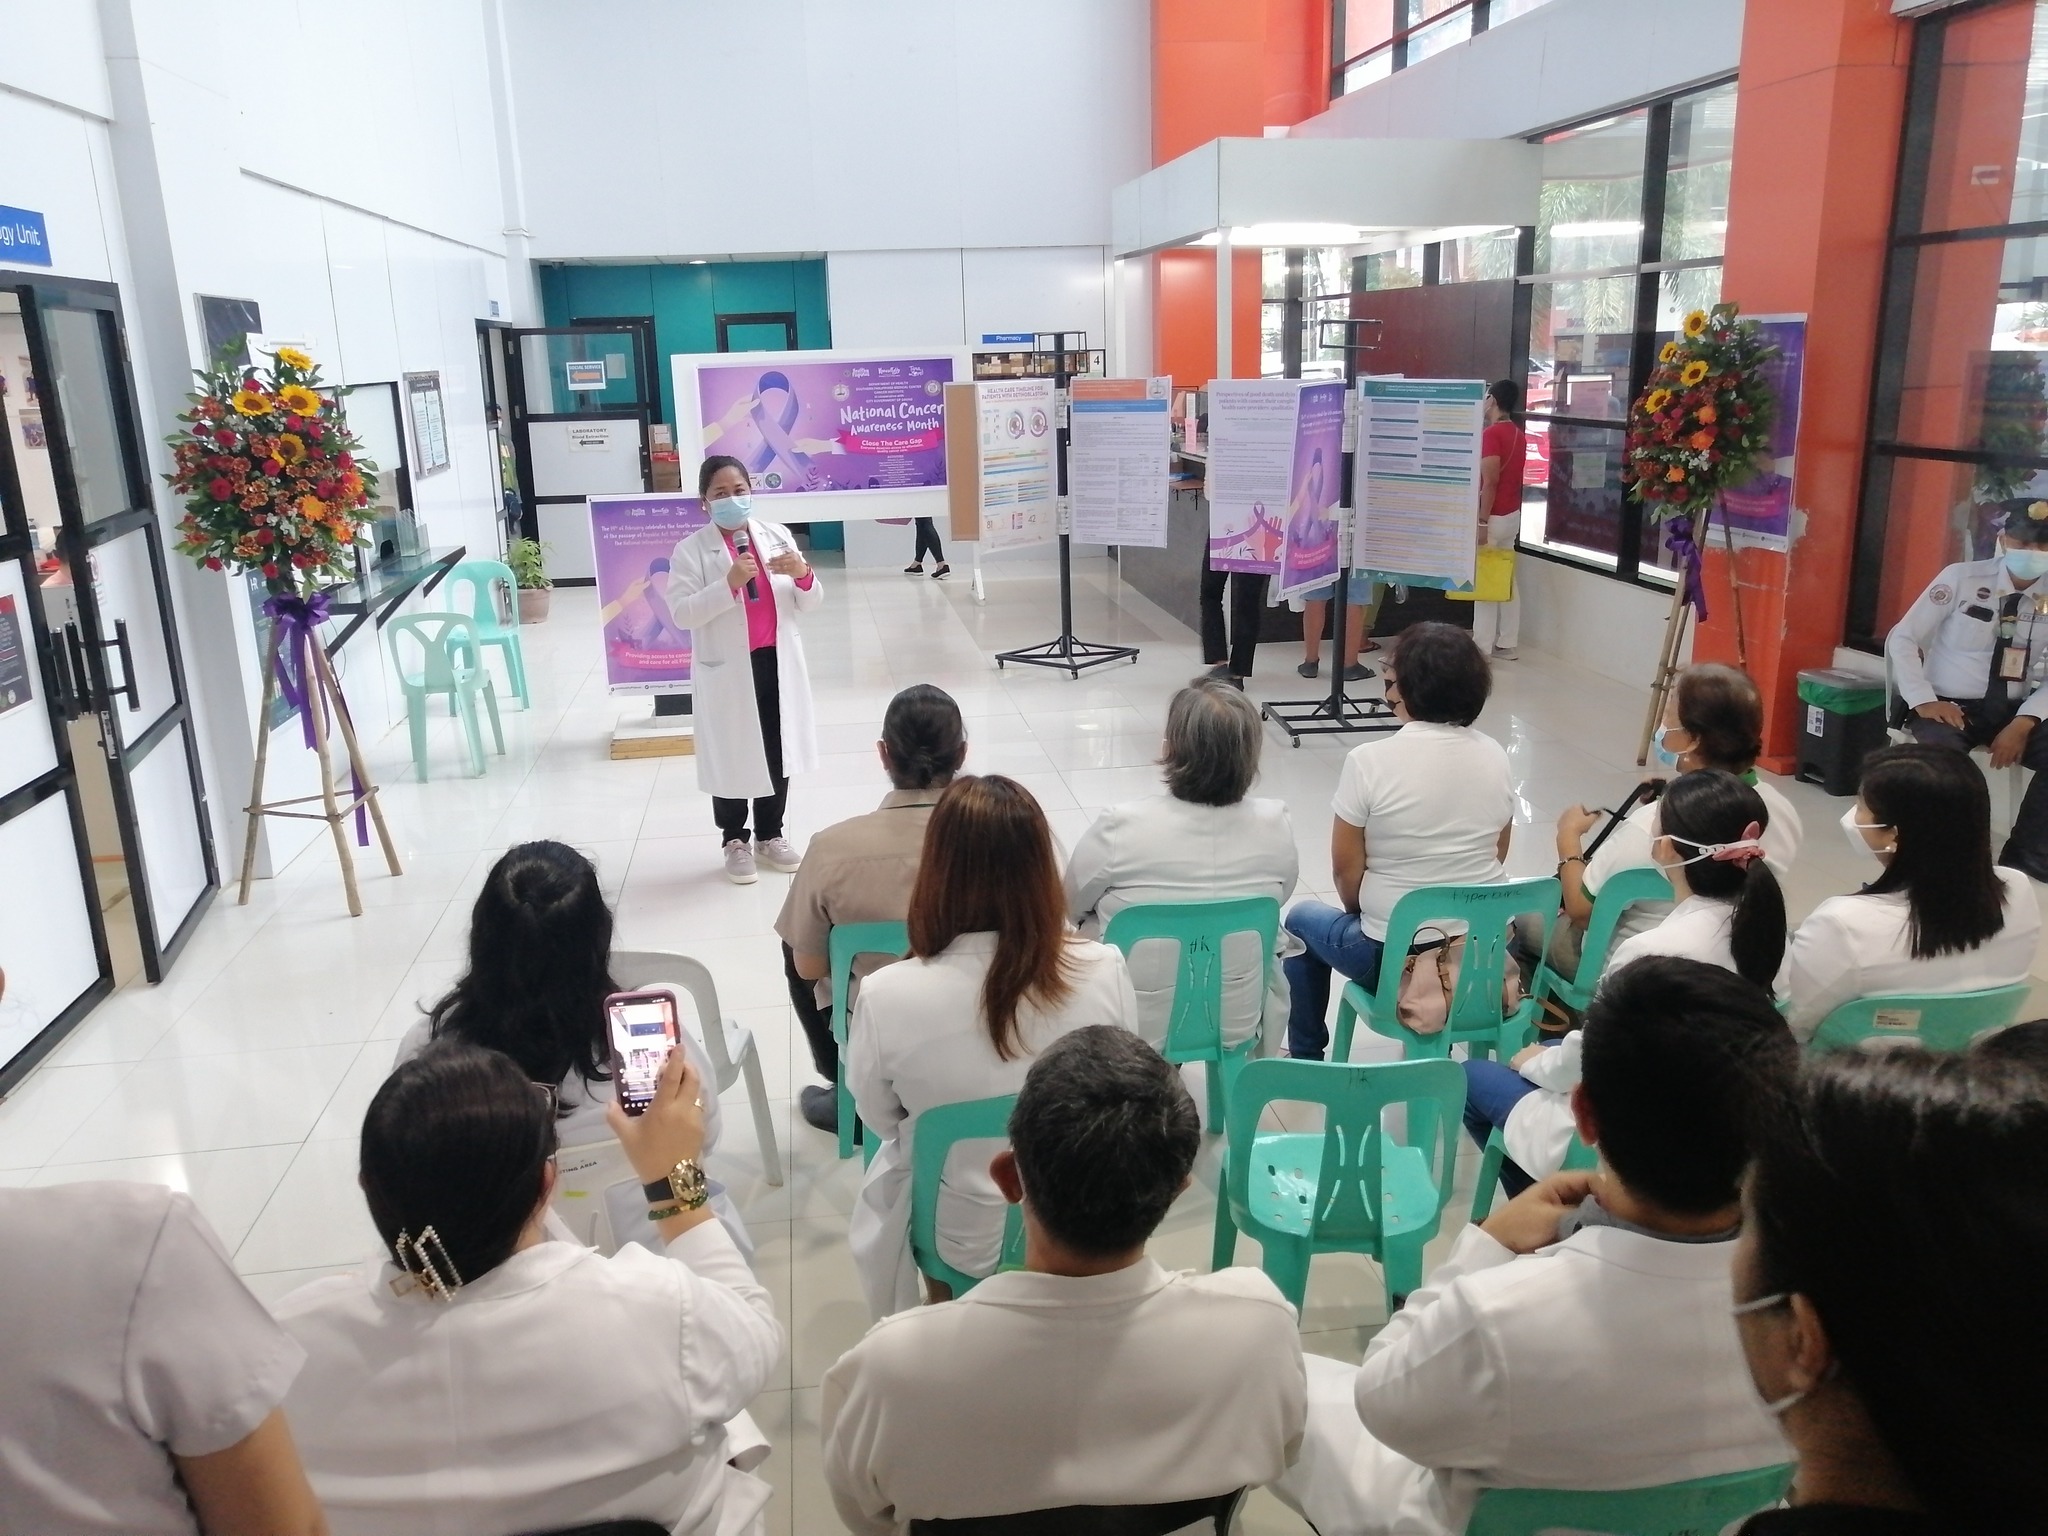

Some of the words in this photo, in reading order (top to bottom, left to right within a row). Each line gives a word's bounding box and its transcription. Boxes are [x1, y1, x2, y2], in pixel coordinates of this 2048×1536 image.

[16, 223, 41, 246] Unit
[1093, 355, 1100, 366] 4
[840, 404, 896, 425] National
[899, 402, 944, 419] Cancer
[850, 422, 903, 436] Awareness
[907, 417, 939, 432] Month
[625, 652, 650, 660] Providing
[580, 1161, 597, 1169] AREA
